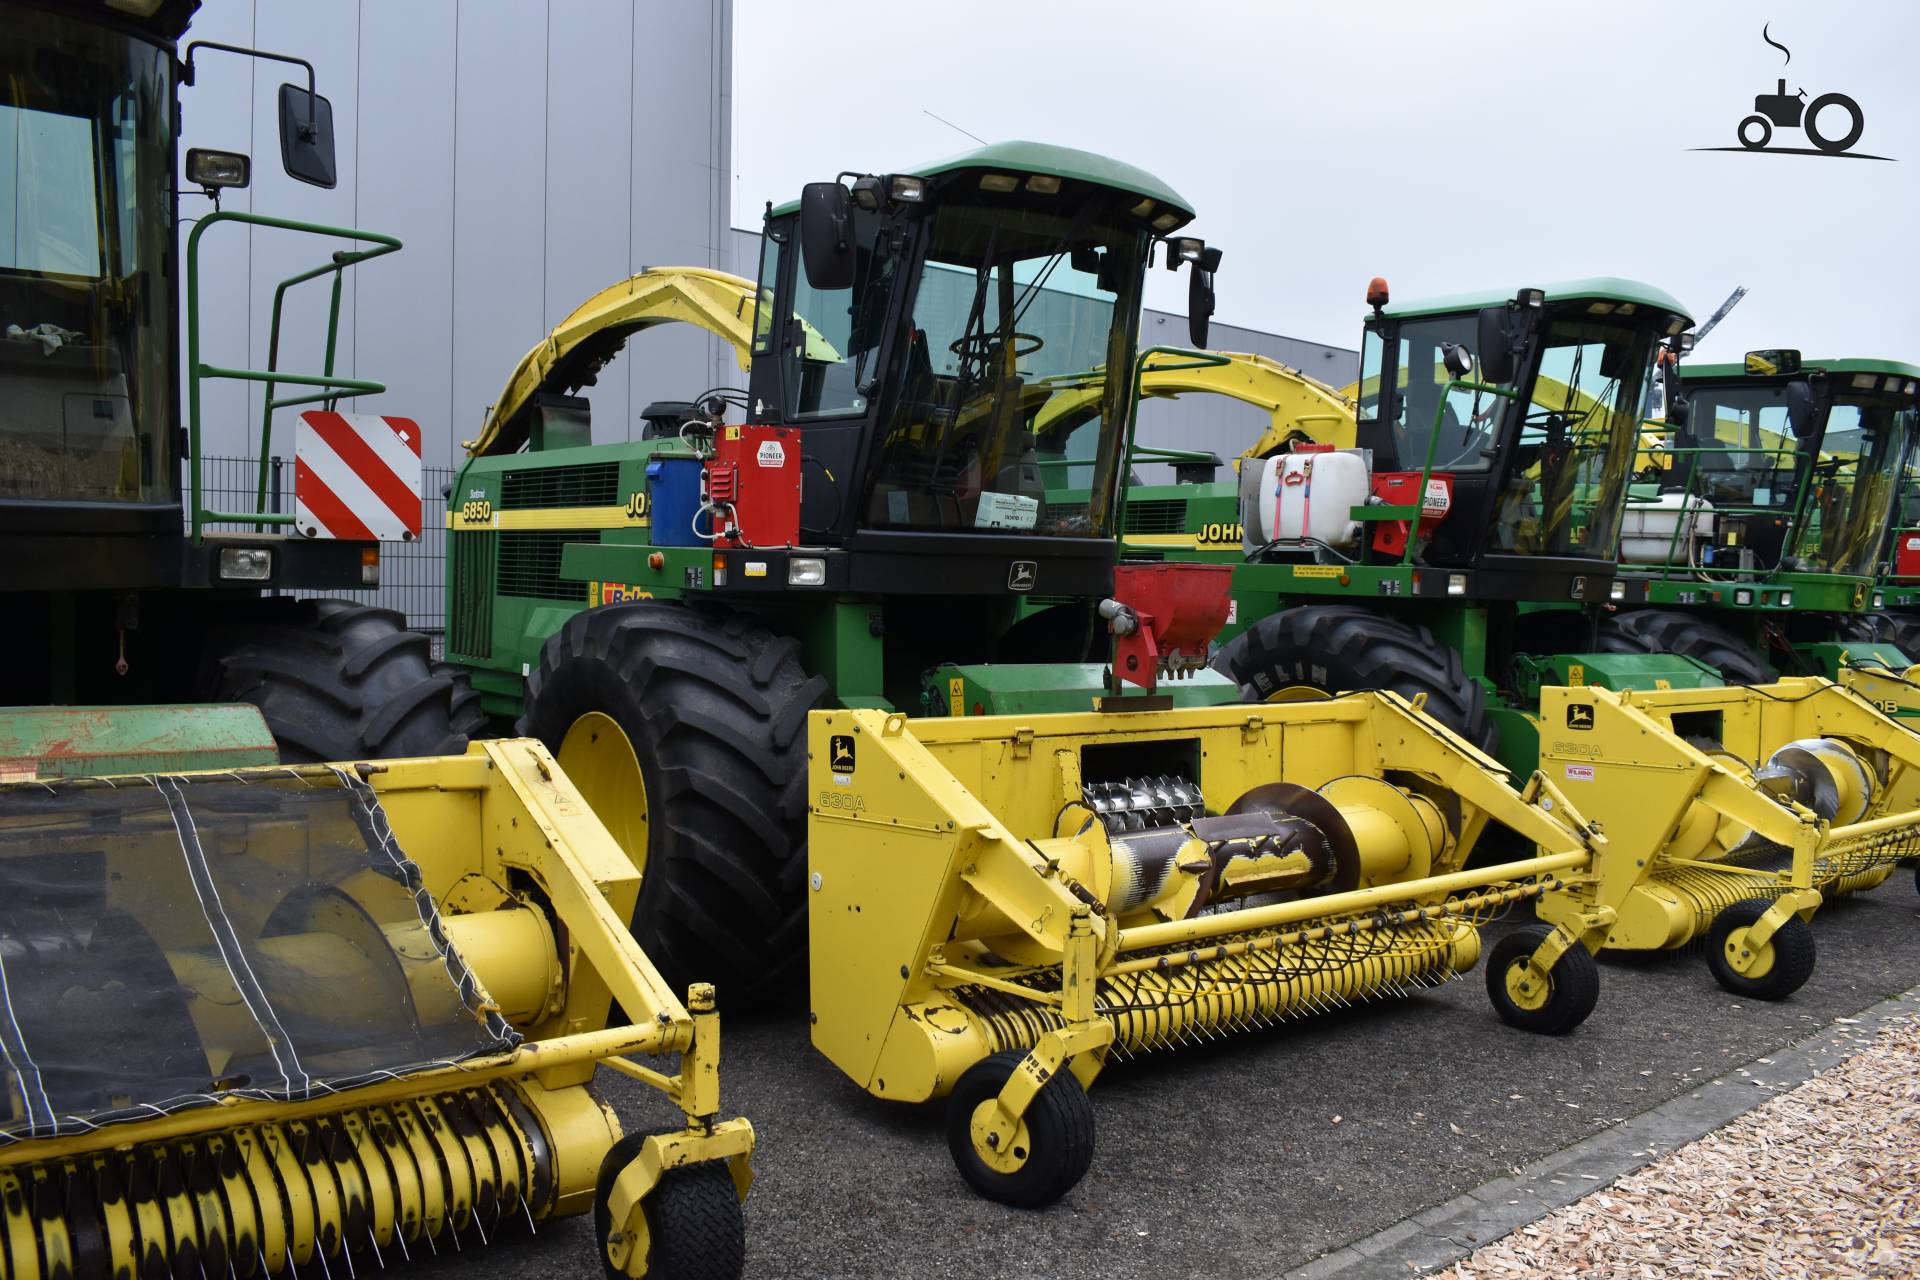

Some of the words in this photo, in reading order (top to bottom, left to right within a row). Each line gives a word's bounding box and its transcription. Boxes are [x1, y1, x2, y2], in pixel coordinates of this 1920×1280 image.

[760, 452, 783, 460] PIONEER
[1424, 496, 1448, 508] PIONEER
[463, 501, 491, 522] 6850
[820, 791, 866, 813] 630A
